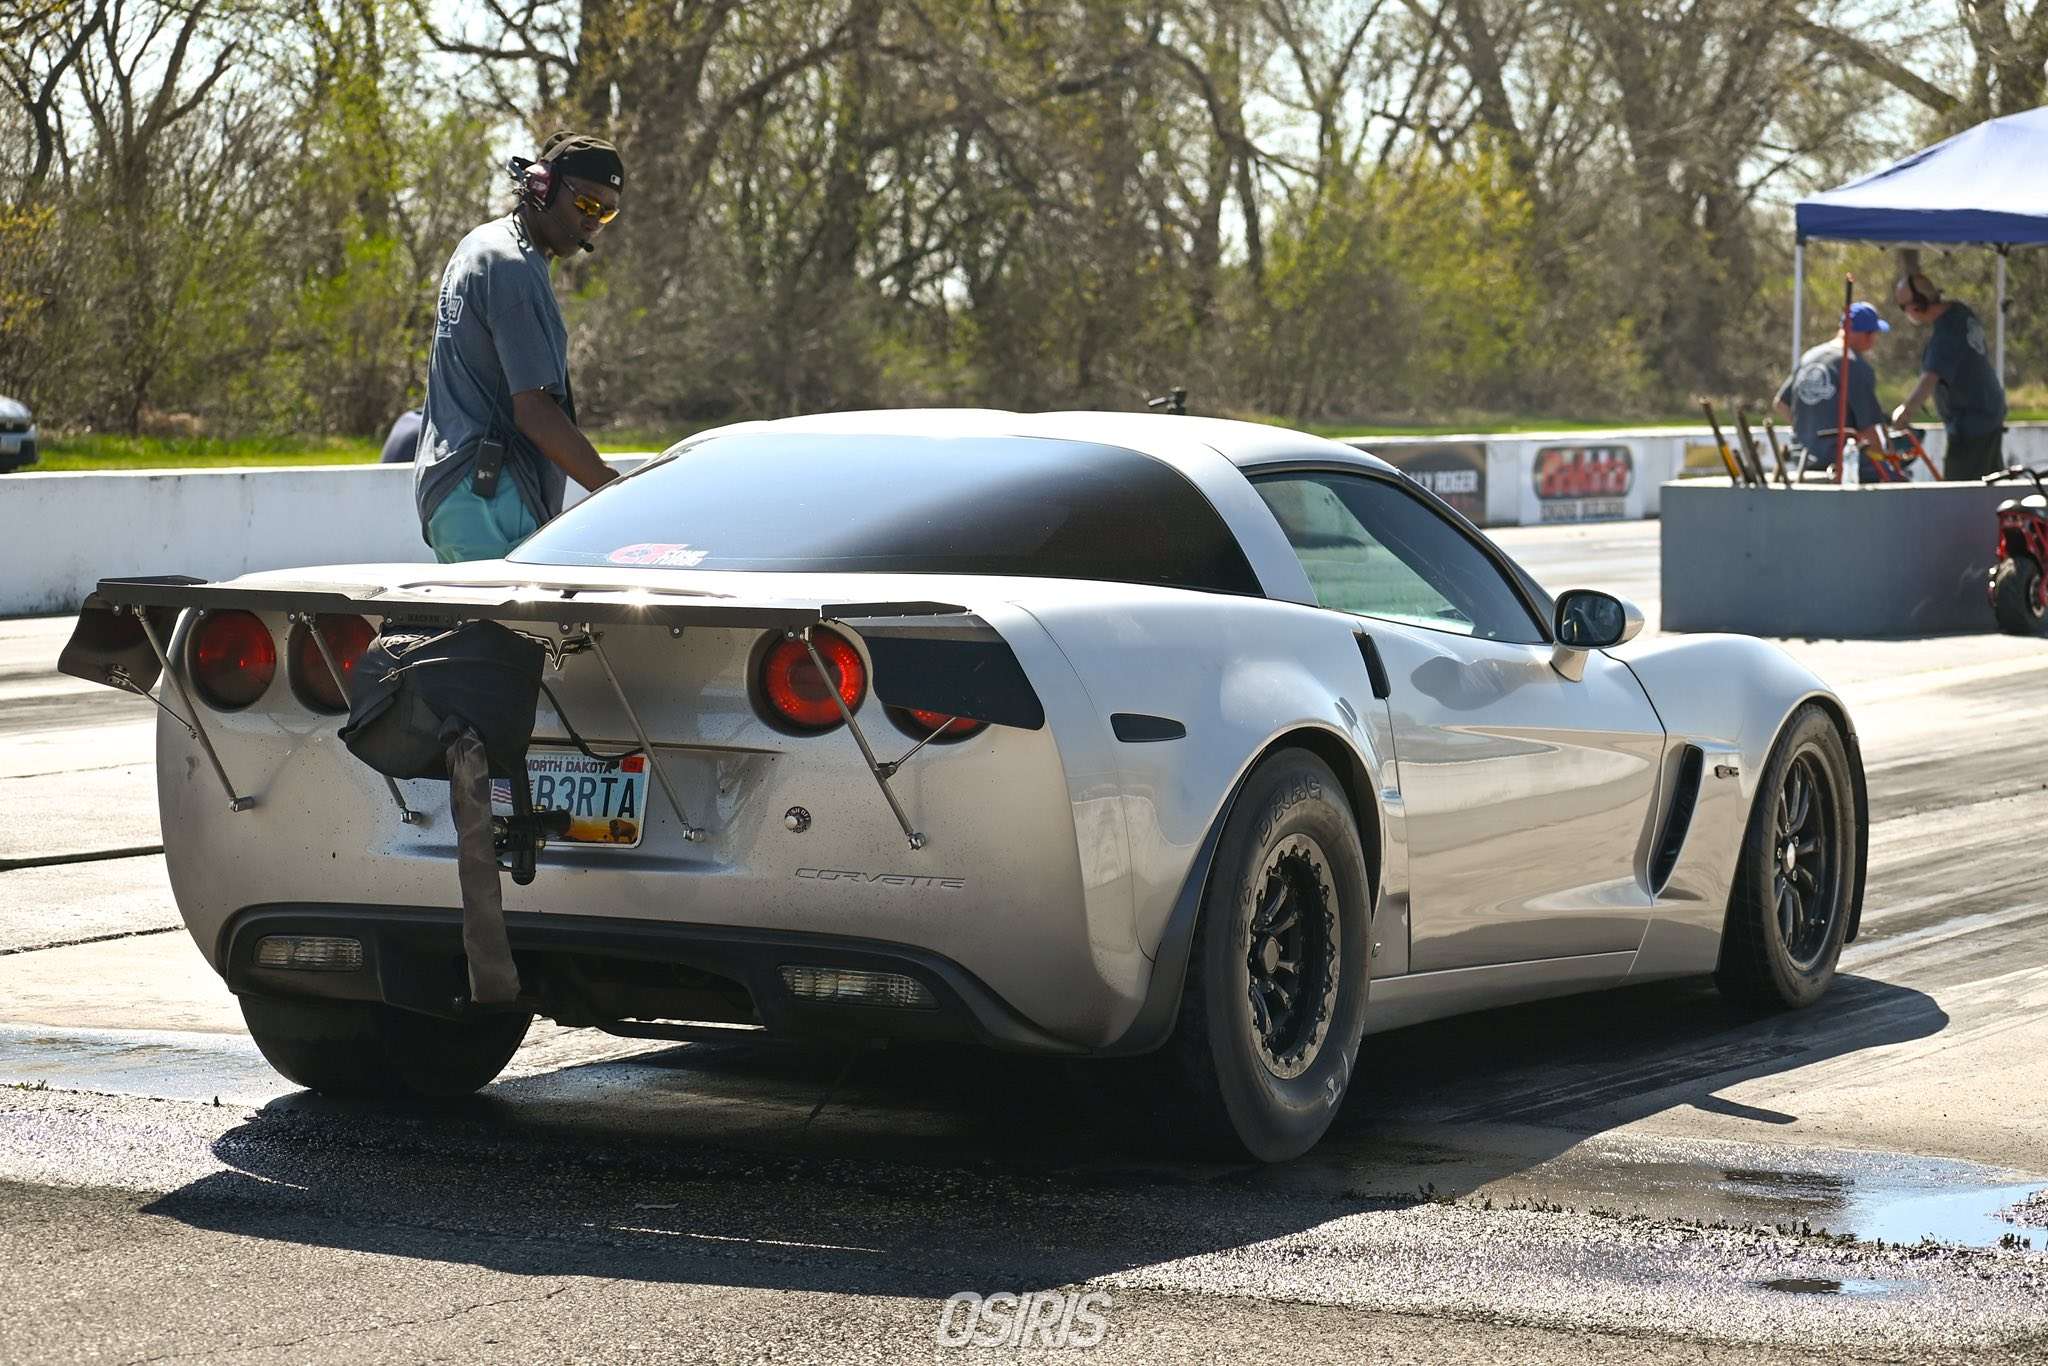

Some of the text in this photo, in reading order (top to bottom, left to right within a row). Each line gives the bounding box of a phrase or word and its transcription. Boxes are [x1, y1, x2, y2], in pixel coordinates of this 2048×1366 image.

[565, 761, 612, 774] DAKOTA
[535, 775, 635, 818] B3RTA
[795, 867, 966, 889] CORVETTE
